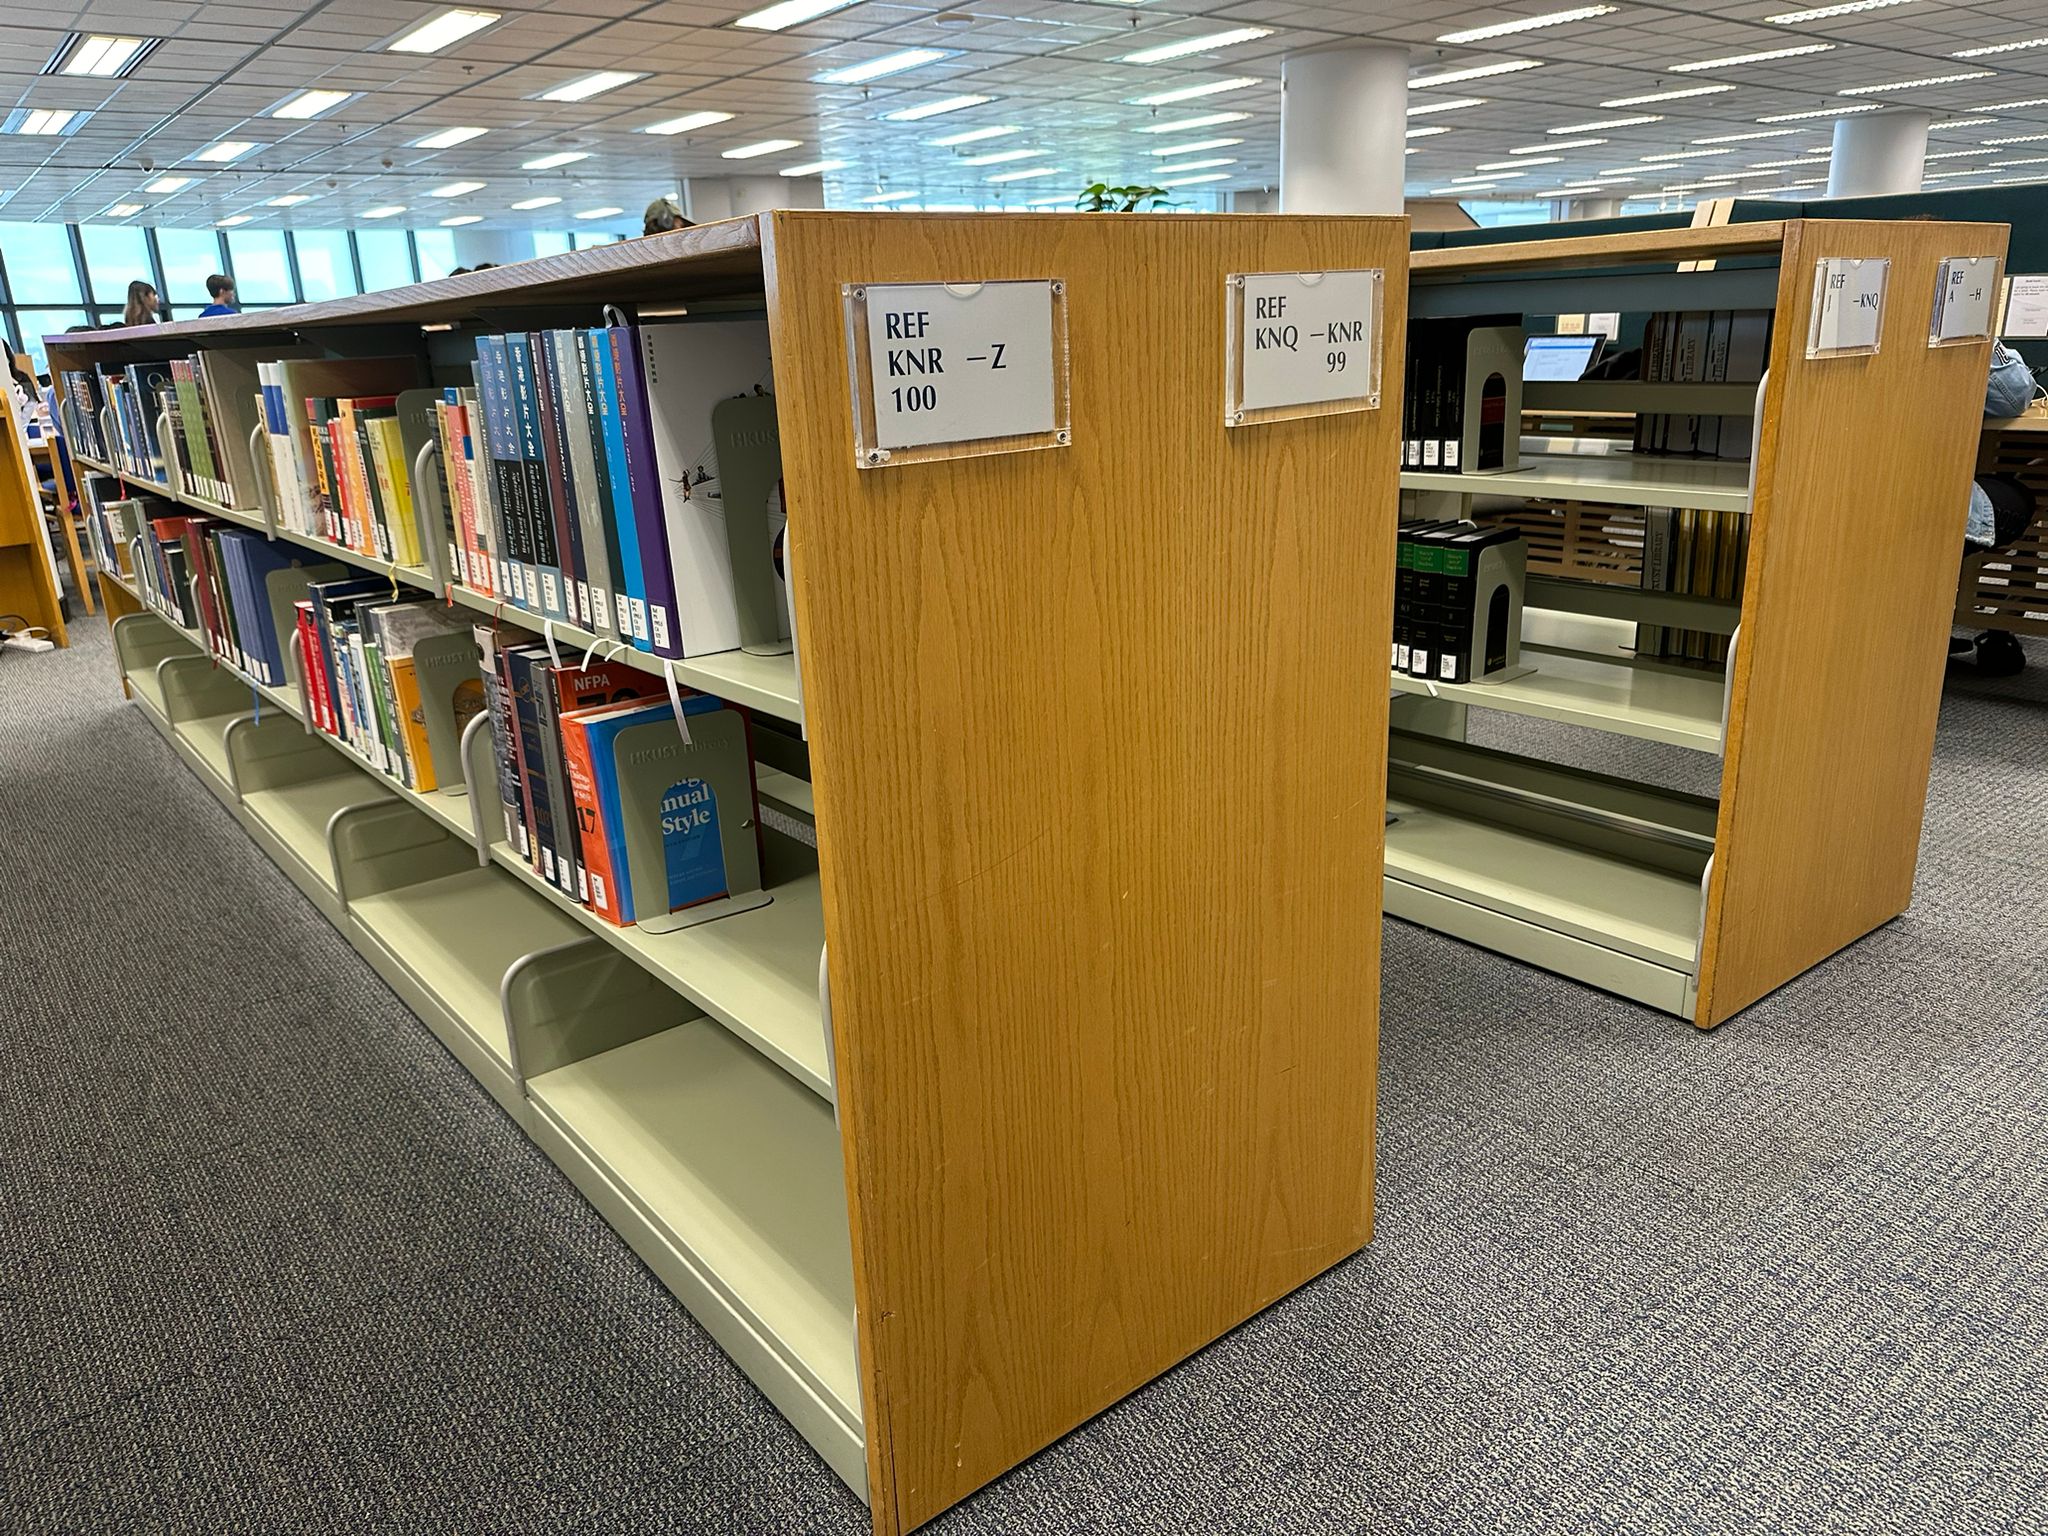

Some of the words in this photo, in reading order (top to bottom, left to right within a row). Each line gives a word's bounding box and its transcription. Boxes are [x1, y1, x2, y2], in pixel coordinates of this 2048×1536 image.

[1830, 273, 1846, 289] REF
[1952, 270, 1965, 285] REF
[1256, 295, 1287, 320] REF
[1949, 289, 1954, 303] A
[885, 311, 930, 340] REF
[1255, 325, 1299, 352] KNQ
[887, 347, 945, 377] KNR
[1326, 351, 1347, 374] 99
[891, 384, 937, 413] 100
[574, 673, 611, 692] NFPA
[577, 806, 596, 834] 17
[662, 808, 712, 835] Style
